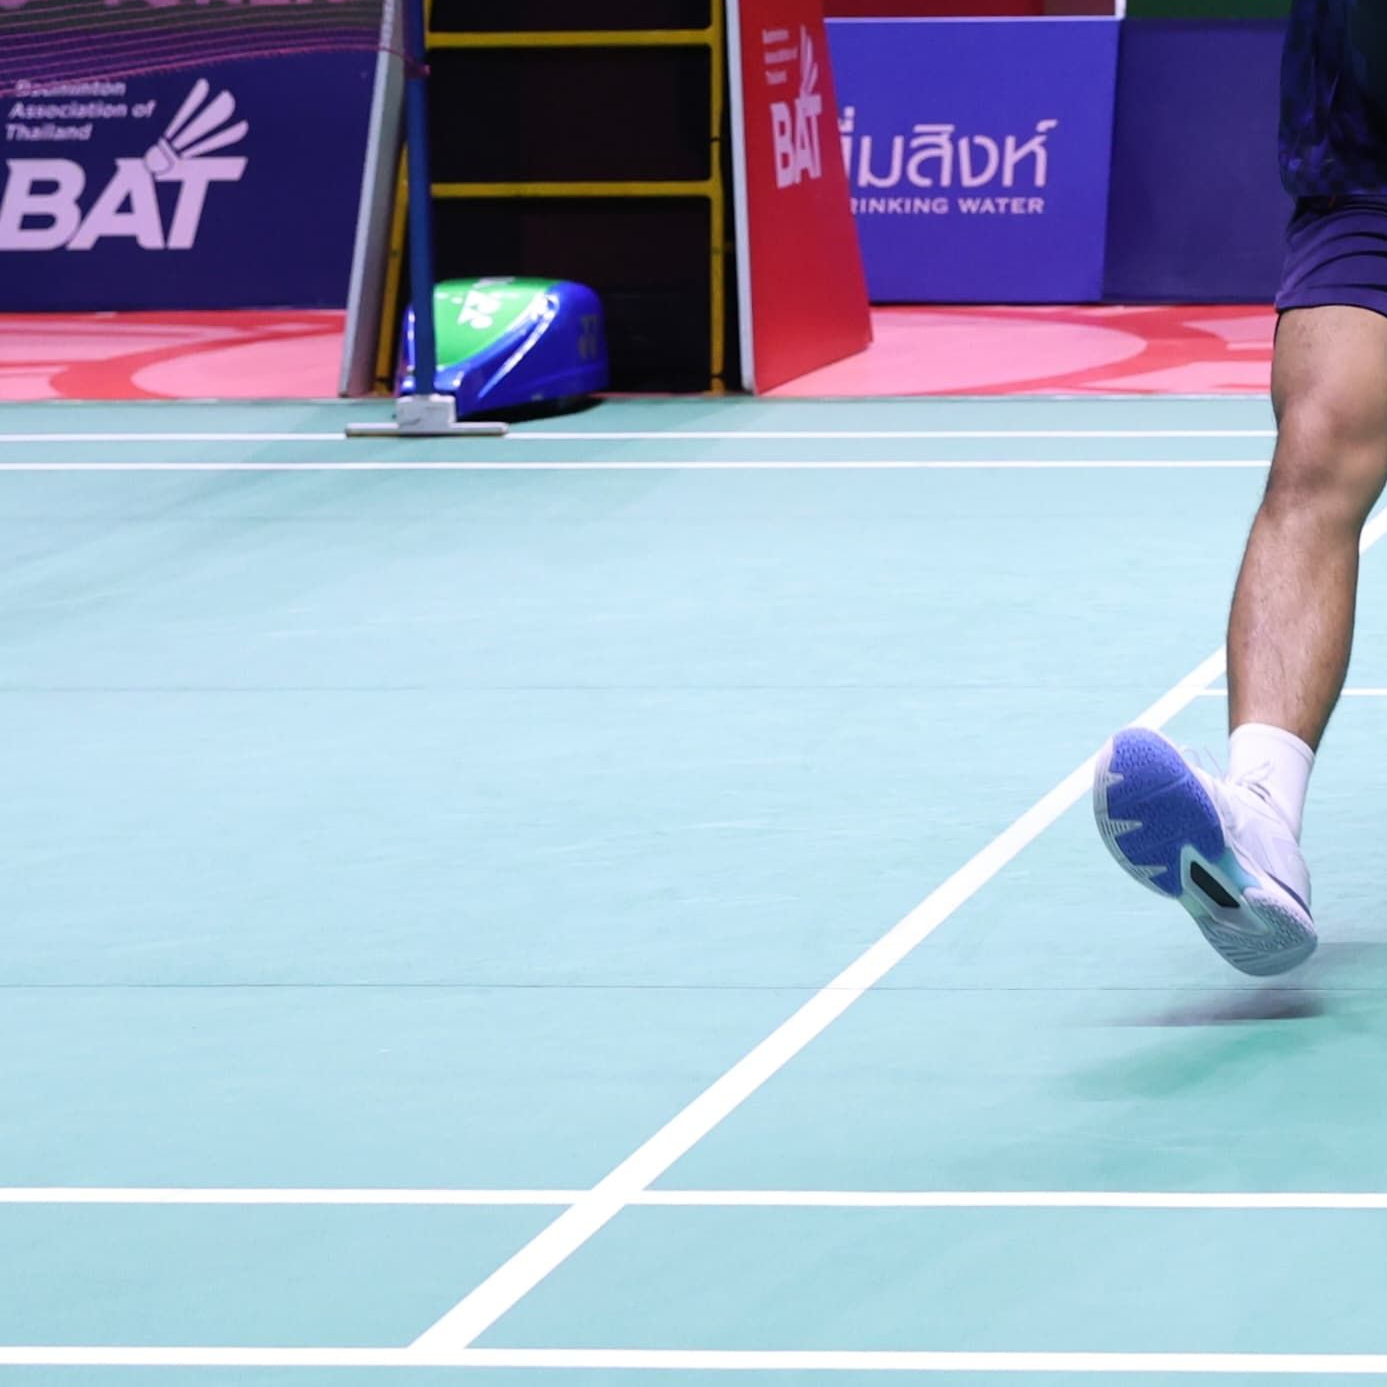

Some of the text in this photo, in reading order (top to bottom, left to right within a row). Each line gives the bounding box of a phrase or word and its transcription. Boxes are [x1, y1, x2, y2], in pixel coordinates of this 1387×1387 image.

[9, 100, 156, 120] Association of
[6, 123, 94, 141] Thailand
[769, 93, 823, 190] BAT
[0, 156, 248, 251] BAT
[958, 196, 1045, 215] WATER
